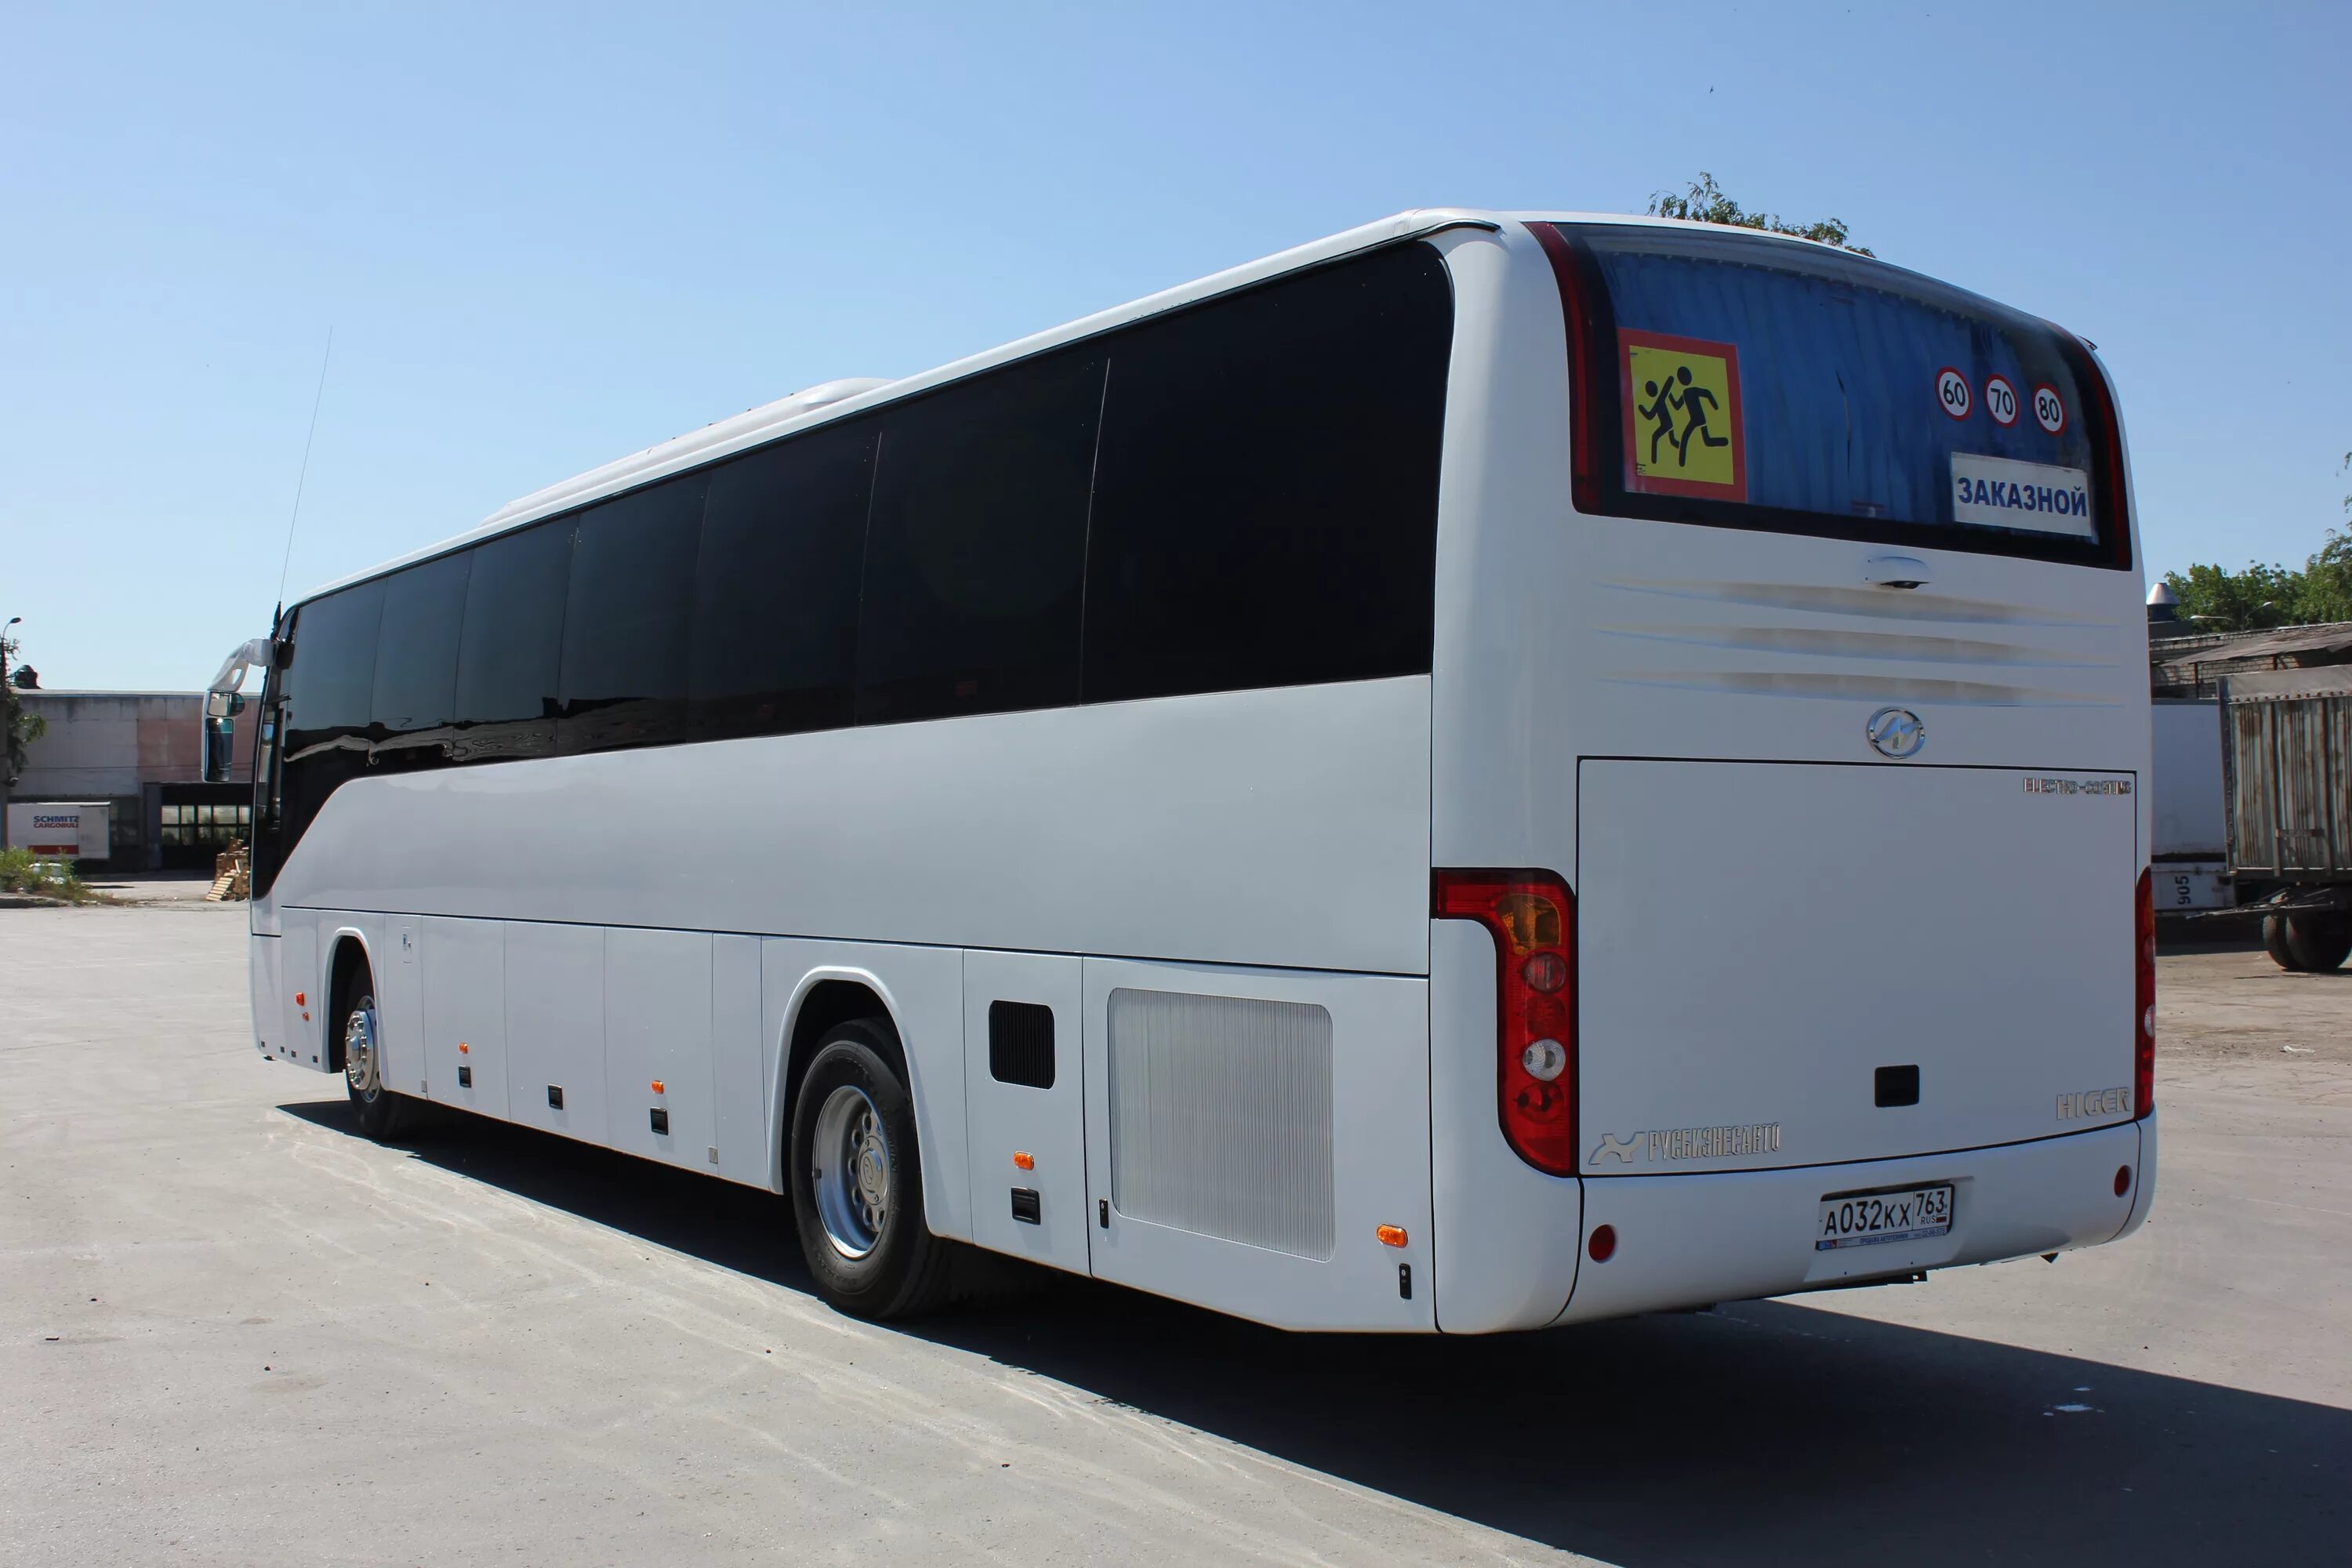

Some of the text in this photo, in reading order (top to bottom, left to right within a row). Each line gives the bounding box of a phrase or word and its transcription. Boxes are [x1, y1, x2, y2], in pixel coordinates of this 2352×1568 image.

[1943, 380, 1965, 407] 60
[1991, 387, 2013, 416] 70
[2038, 396, 2060, 423] 80
[1957, 477, 2087, 517] ЗАКАЗНОЙ
[2175, 875, 2191, 905] 905
[2056, 1087, 2131, 1120] HIGER
[1649, 1122, 1780, 1162] РУСБИЗНЕСАВТО
[1915, 1190, 1945, 1216] 763
[1921, 1215, 1936, 1225] RUS
